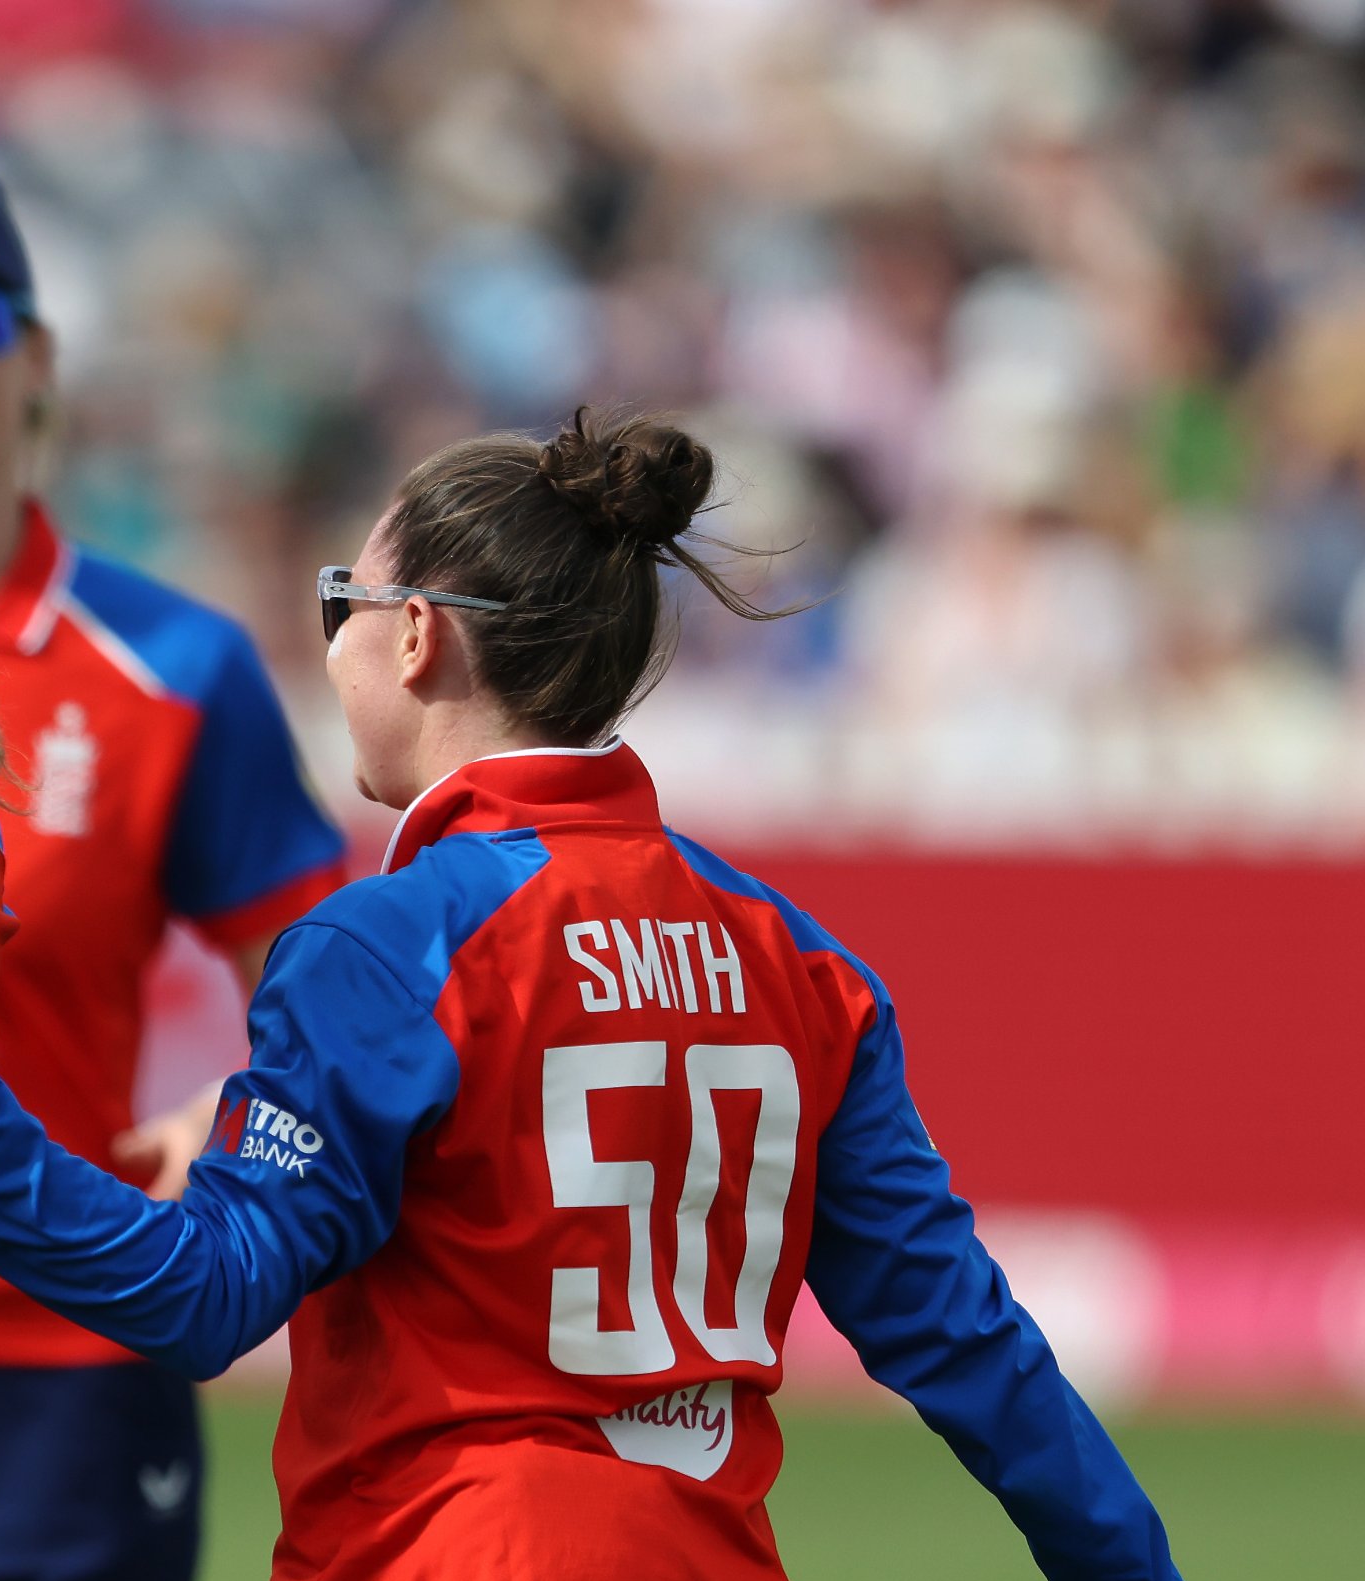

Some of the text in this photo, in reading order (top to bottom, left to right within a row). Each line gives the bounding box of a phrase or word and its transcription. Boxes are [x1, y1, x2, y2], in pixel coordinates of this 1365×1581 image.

[239, 1135, 313, 1179] BANK
[542, 1041, 800, 1376] 50
[597, 1382, 726, 1452] ality
